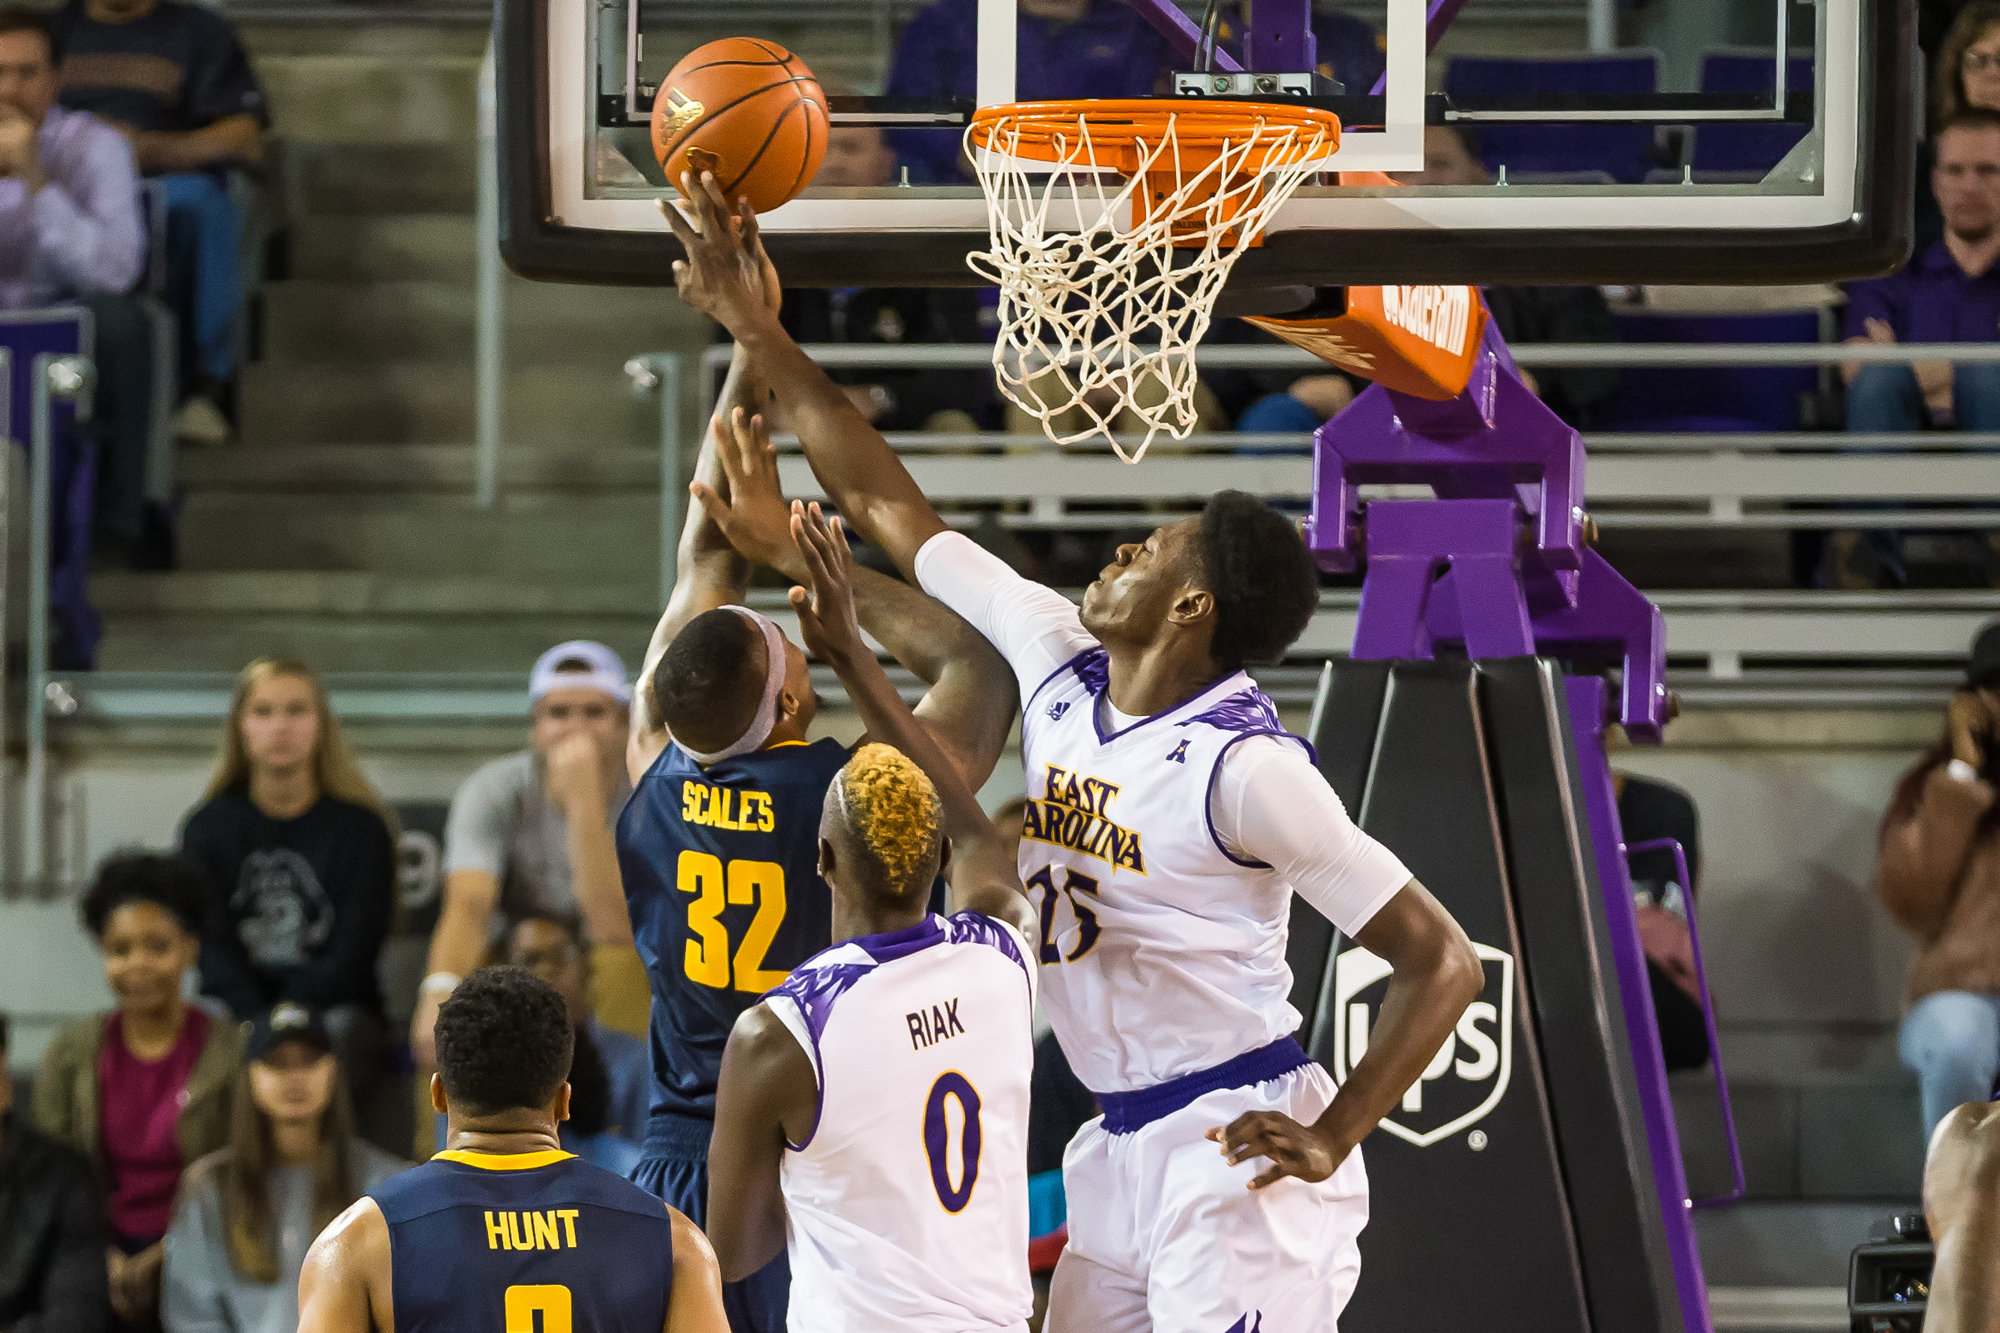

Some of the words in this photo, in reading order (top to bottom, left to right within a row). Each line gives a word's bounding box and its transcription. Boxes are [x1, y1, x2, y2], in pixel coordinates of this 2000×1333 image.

[1172, 220, 1208, 231] PALDIN
[682, 780, 775, 833] SCALES
[1045, 762, 1122, 818] EAST
[1022, 798, 1148, 877] AROLINA
[676, 849, 792, 995] 32
[1025, 863, 1102, 966] 25
[906, 997, 966, 1050] RIAK
[921, 1068, 983, 1216] 0
[484, 1209, 579, 1251] HUNT
